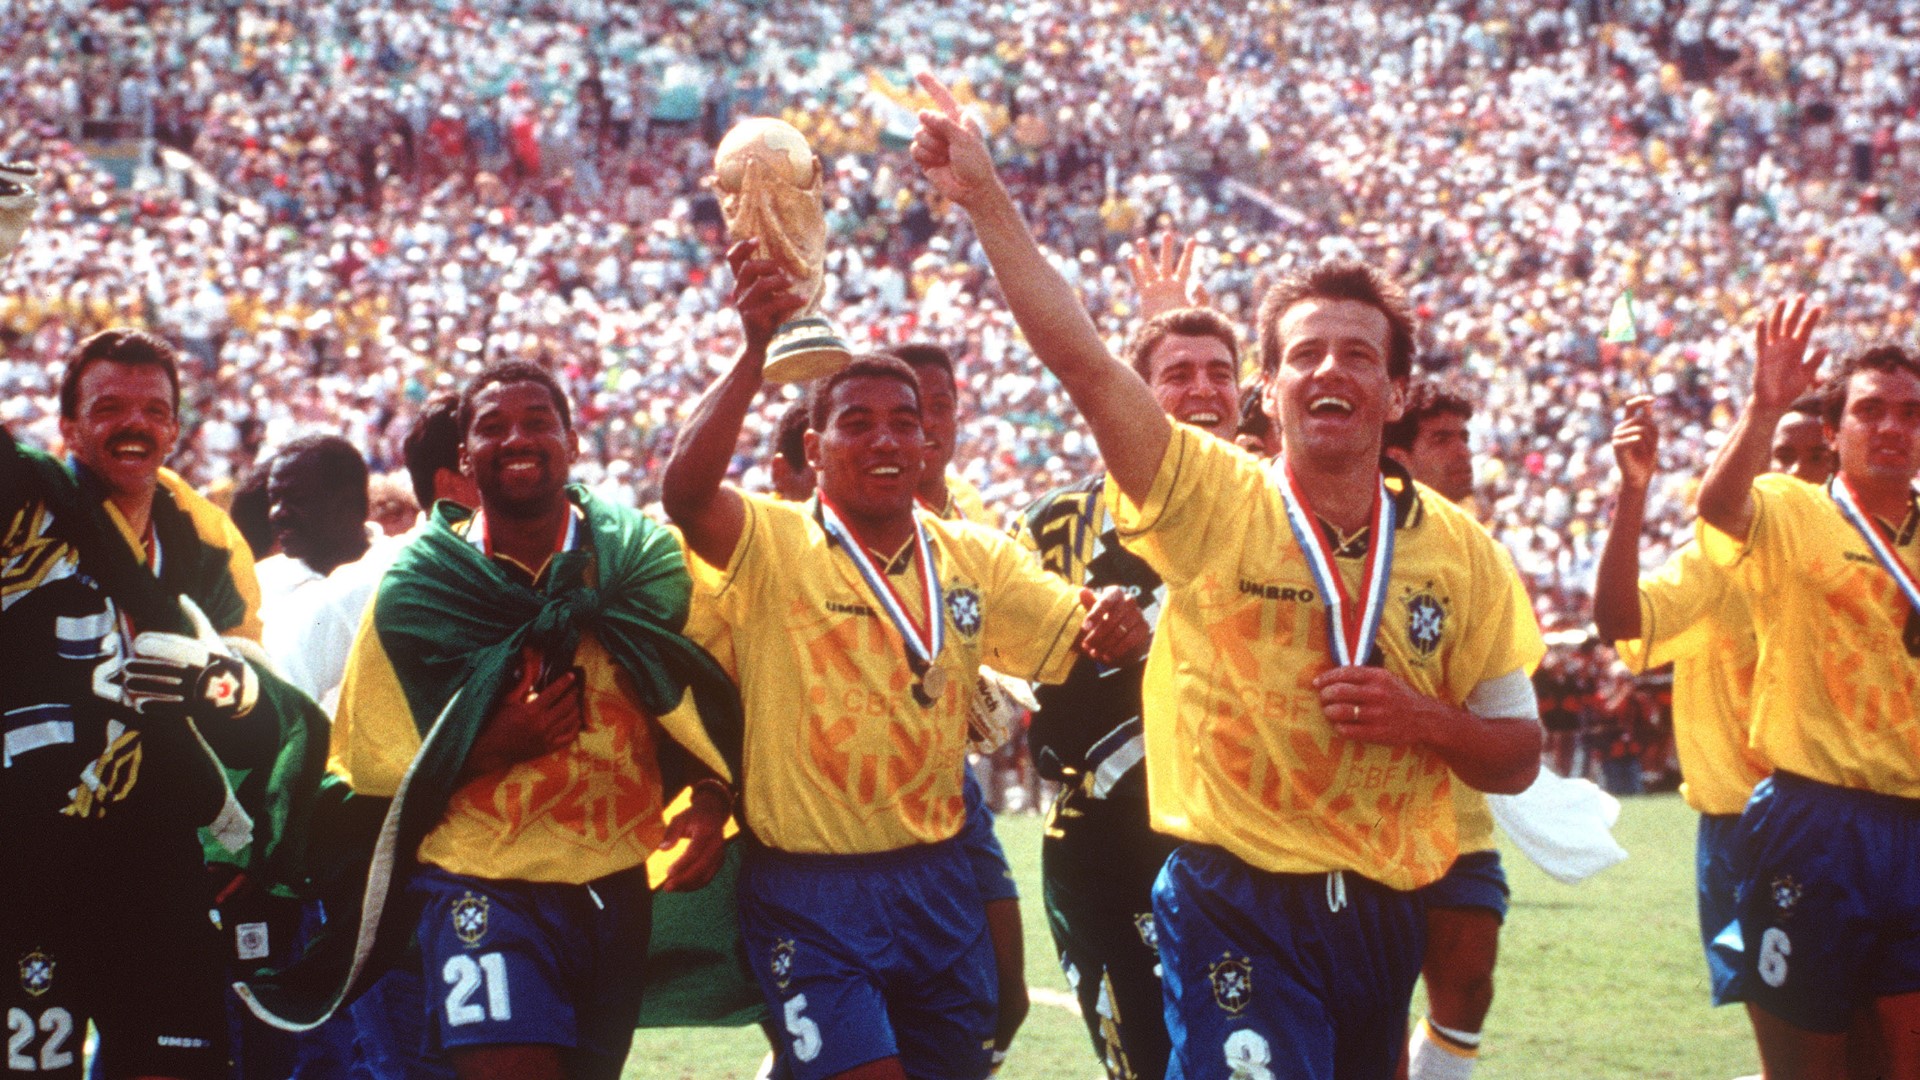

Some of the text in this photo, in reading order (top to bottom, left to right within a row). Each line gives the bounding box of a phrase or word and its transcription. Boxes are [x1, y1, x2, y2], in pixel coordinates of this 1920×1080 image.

[825, 600, 880, 617] UMBR
[1239, 579, 1314, 603] UMBRO
[1238, 687, 1314, 722] CBF
[1345, 763, 1400, 790] CBF
[1758, 926, 1792, 988] 6
[443, 951, 512, 1027] 21
[7, 1006, 74, 1071] 22
[783, 992, 823, 1062] 5
[1223, 1028, 1277, 1080] 8
